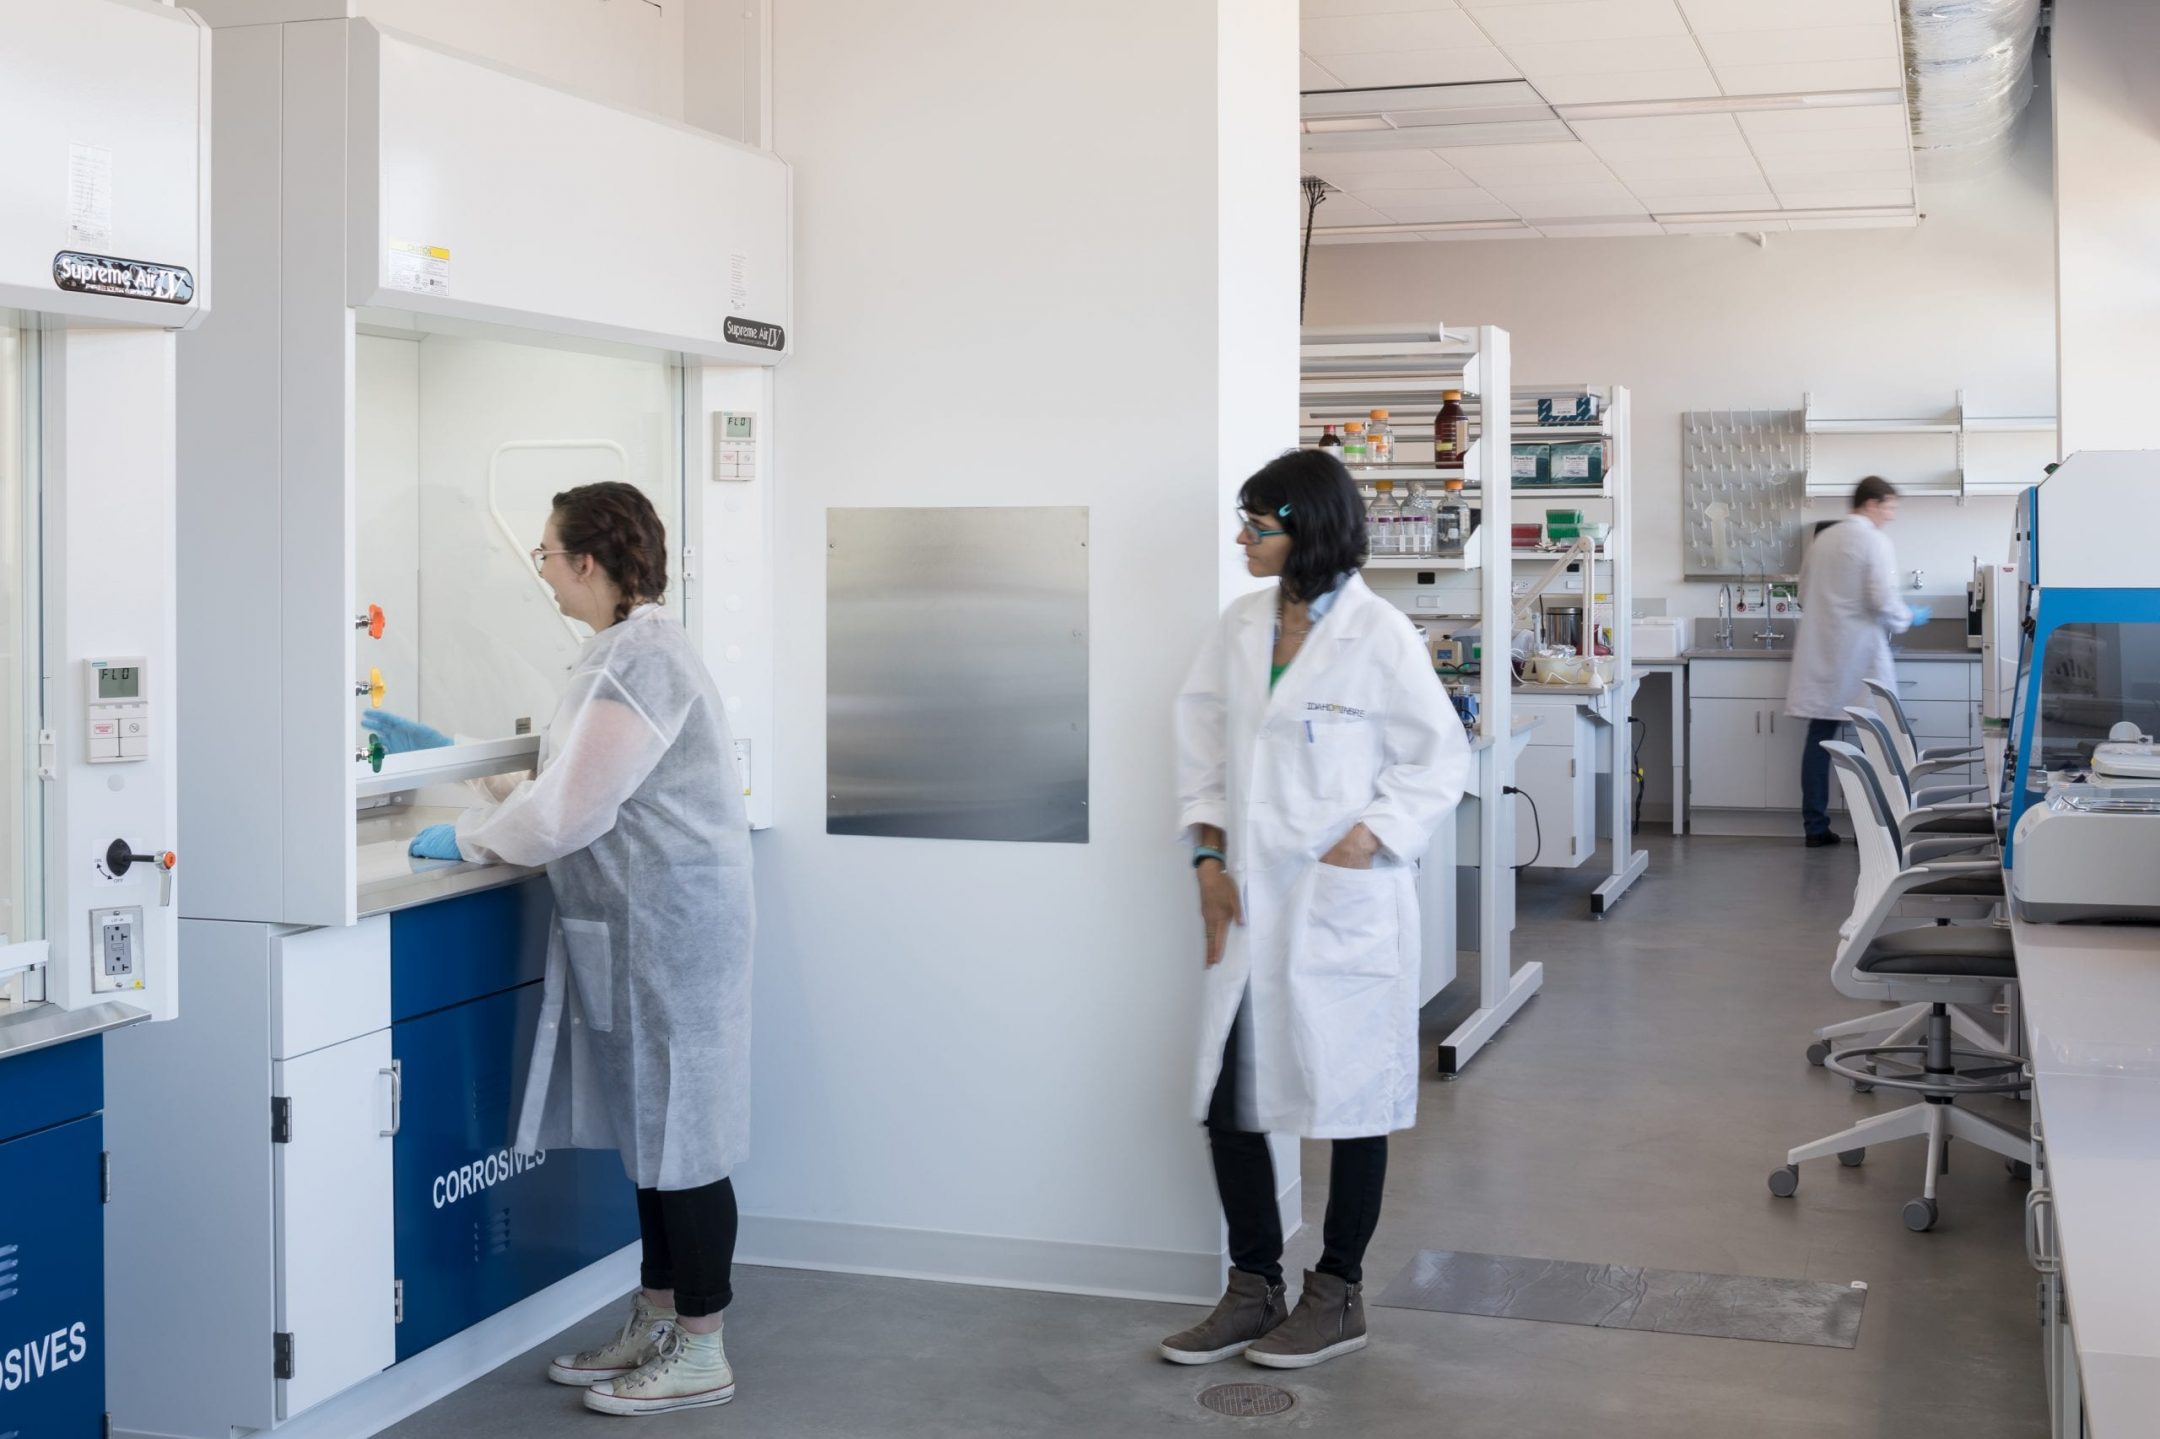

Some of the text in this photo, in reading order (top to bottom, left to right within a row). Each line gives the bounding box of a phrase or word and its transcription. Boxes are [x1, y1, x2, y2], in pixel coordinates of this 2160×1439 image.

[62, 257, 131, 286] Supreme
[134, 266, 156, 289] Air
[727, 320, 757, 338] Supreme
[758, 327, 768, 341] Air
[0, 1321, 87, 1391] SIVES
